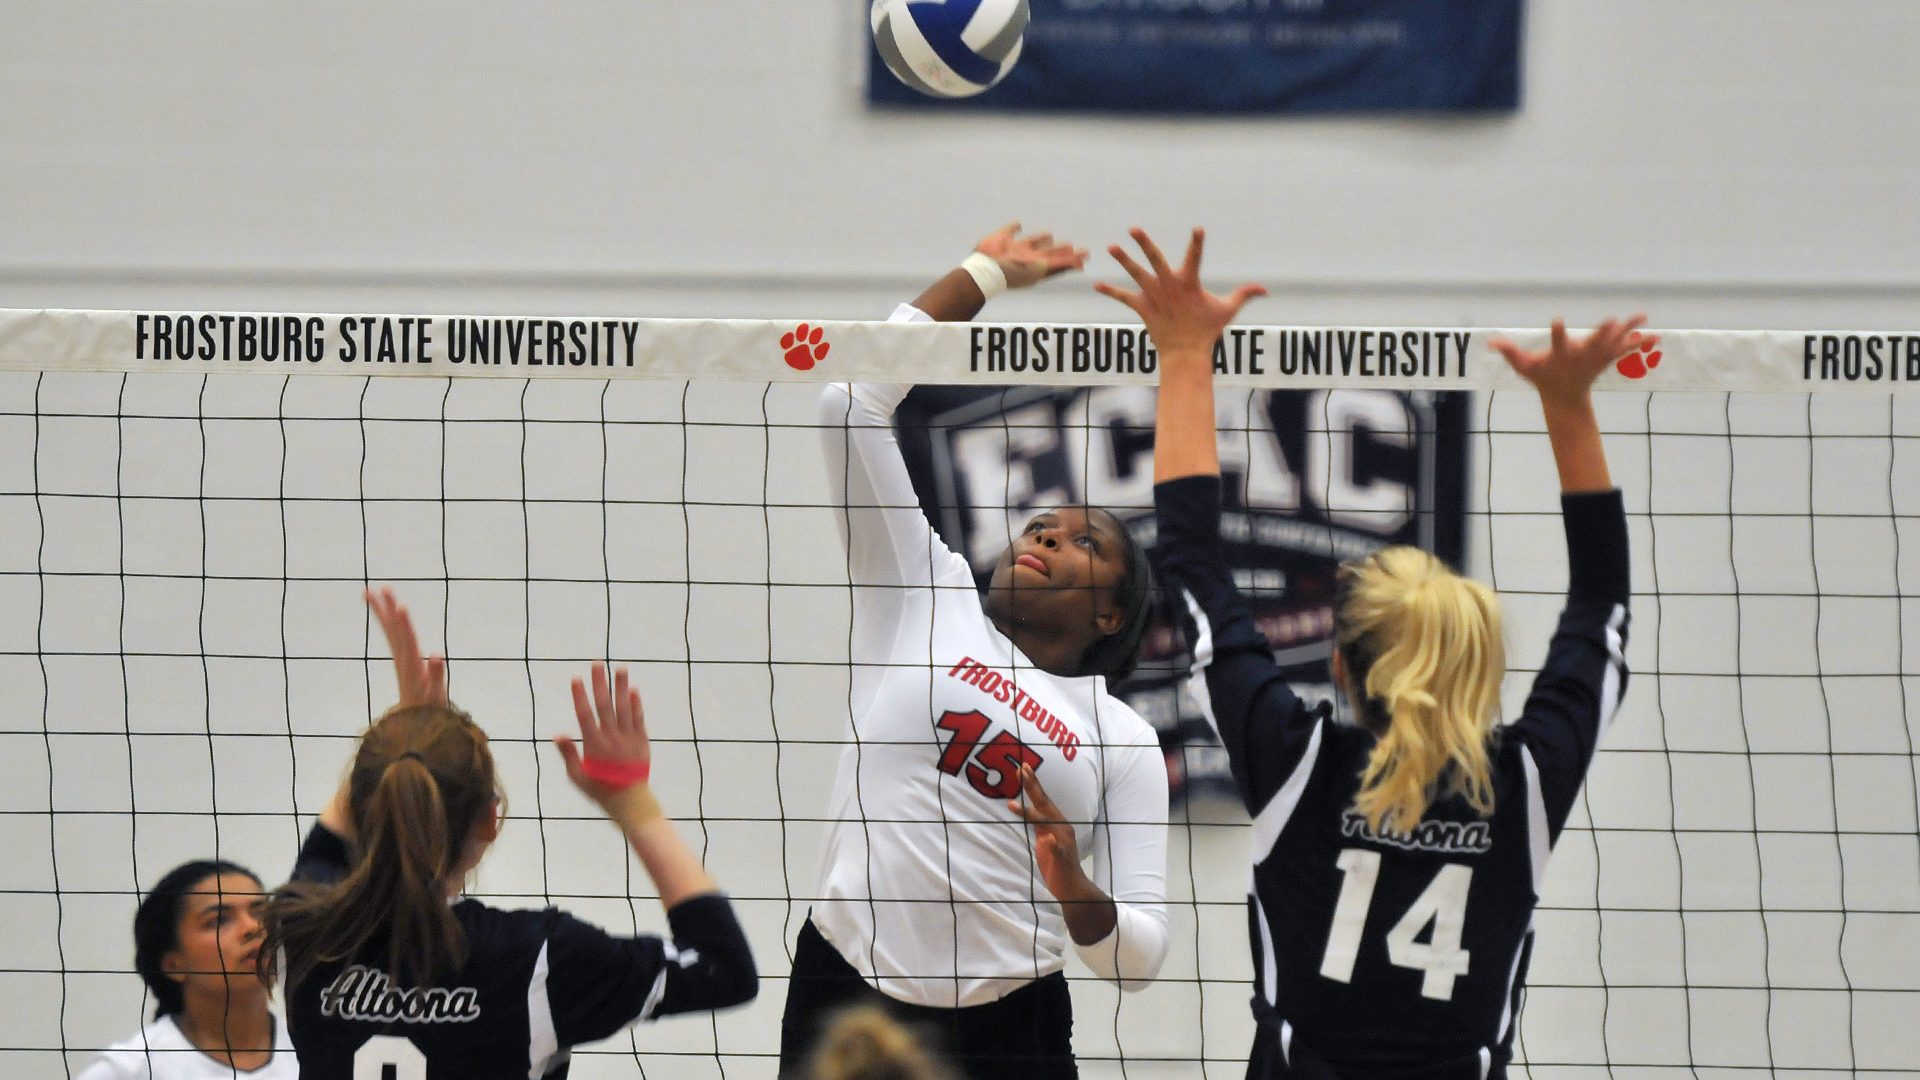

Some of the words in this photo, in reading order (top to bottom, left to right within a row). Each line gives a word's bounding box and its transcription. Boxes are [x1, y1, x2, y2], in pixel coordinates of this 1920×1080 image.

[136, 314, 325, 363] FROSTBURG
[338, 317, 433, 364] STATE
[448, 318, 640, 367] UNIVERSITY
[970, 326, 1157, 373] FROSTBURG
[1212, 329, 1265, 375] ATE
[1279, 330, 1471, 377] UNIVERSITY
[948, 656, 1080, 763] FROSTBURG
[936, 708, 1044, 799] 15
[1319, 848, 1473, 1001] 14
[320, 964, 481, 1024] Altoona
